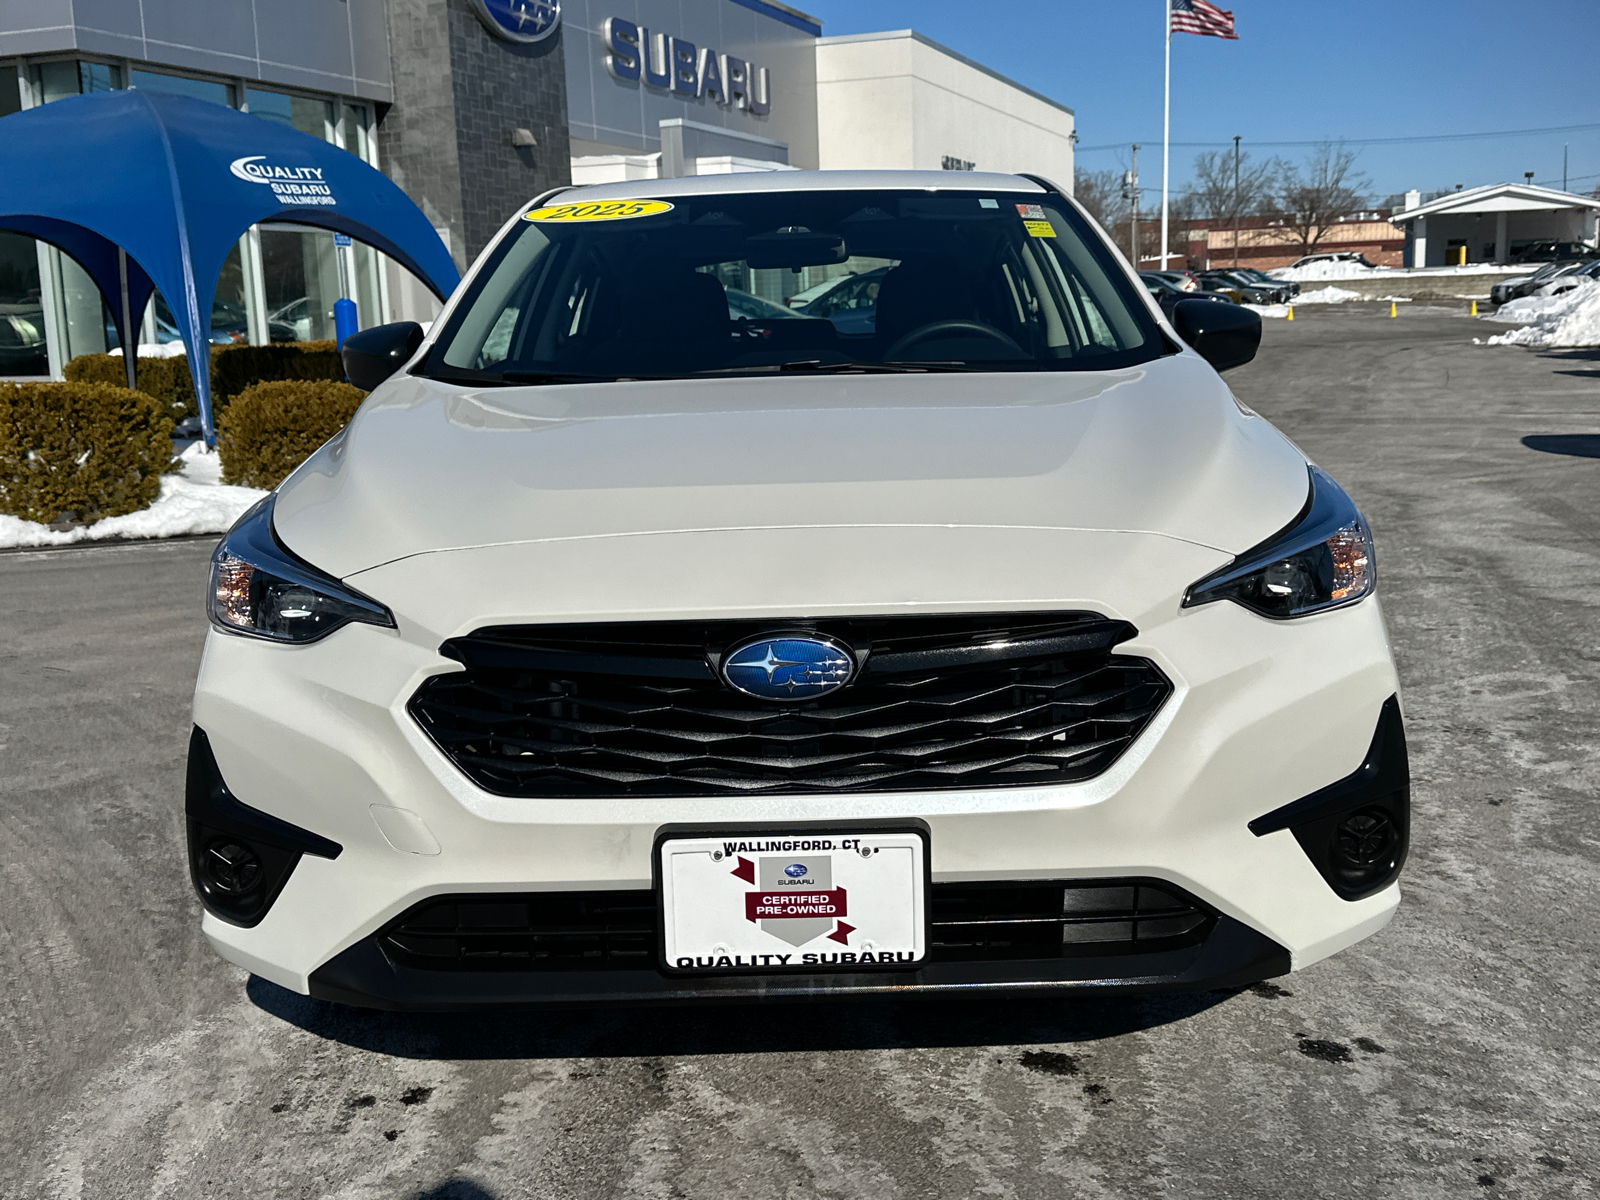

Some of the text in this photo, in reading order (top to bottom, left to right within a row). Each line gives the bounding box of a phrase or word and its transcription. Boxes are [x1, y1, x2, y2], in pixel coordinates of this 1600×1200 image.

[604, 17, 770, 116] SUBARU
[246, 163, 322, 180] QUALITY
[271, 183, 331, 195] SUBARU
[276, 195, 337, 205] WALLINGFORD
[544, 203, 652, 219] 2025
[723, 839, 861, 852] WALLINGFORD, CT
[762, 895, 829, 905] CERTIFIED
[756, 904, 836, 915] PRE-OWNED
[676, 951, 915, 969] QUALITY SUBARU
